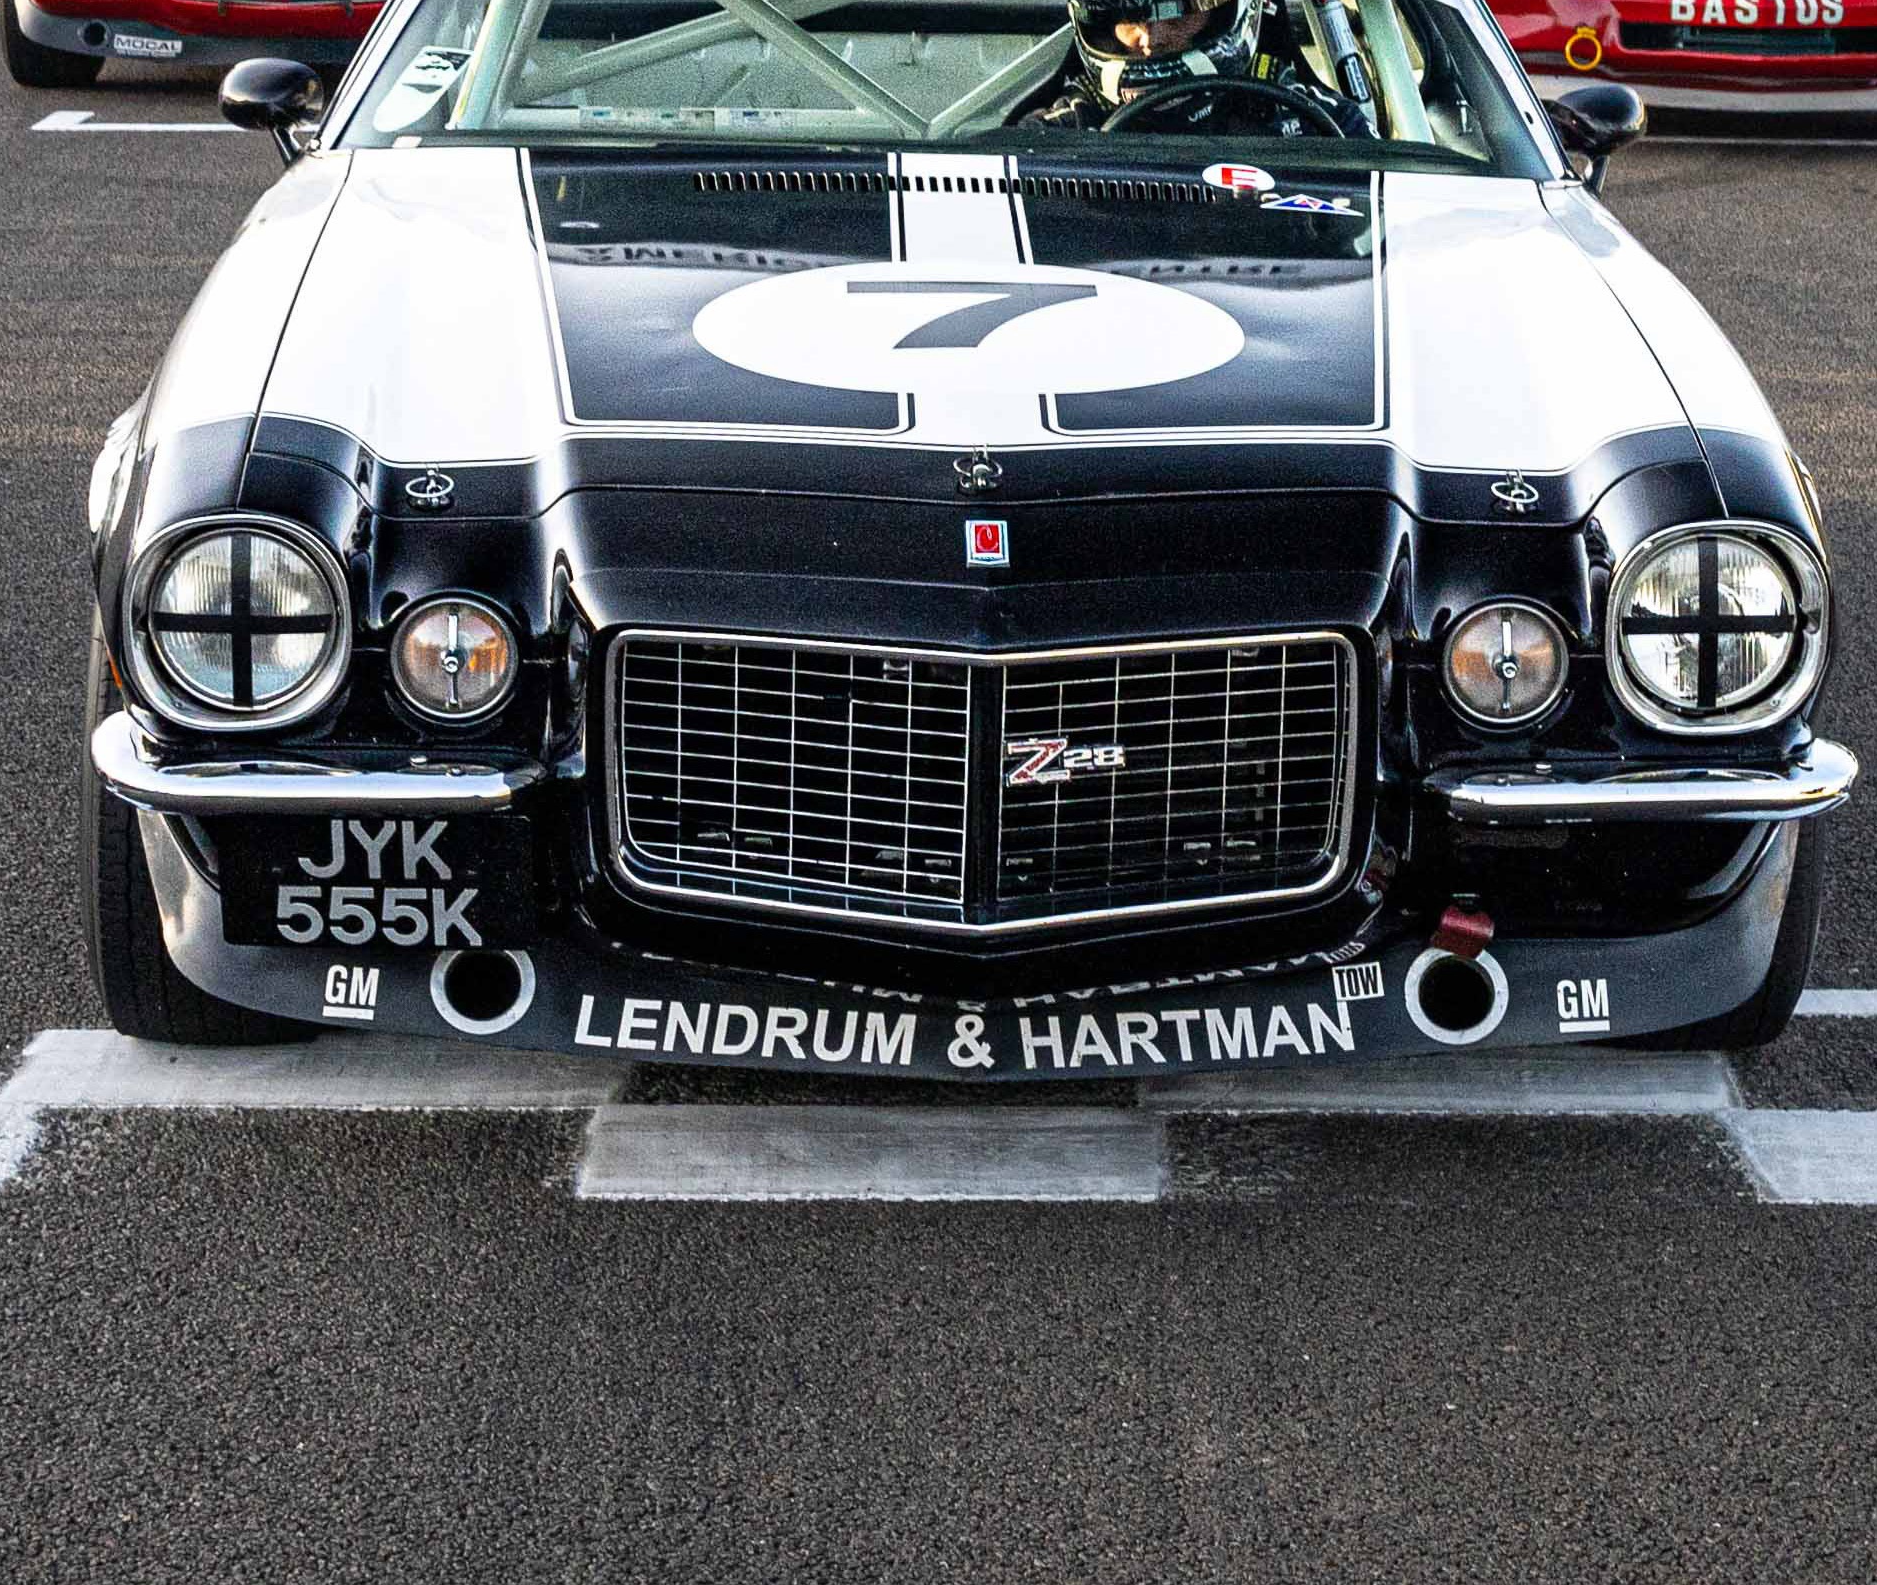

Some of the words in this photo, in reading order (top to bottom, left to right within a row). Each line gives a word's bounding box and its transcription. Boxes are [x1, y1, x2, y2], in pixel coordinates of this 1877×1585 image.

[117, 36, 179, 52] MOCAL
[846, 280, 1100, 350] 7
[1006, 737, 1126, 788] Z28
[297, 818, 453, 880] JYK
[276, 885, 483, 947] 555K
[324, 964, 380, 1008] GM
[1335, 966, 1380, 999] TOW
[1556, 979, 1610, 1018] GM
[573, 993, 919, 1066] LENDRUM
[946, 1014, 996, 1070] &
[1019, 1002, 1357, 1070] HARTMAN
